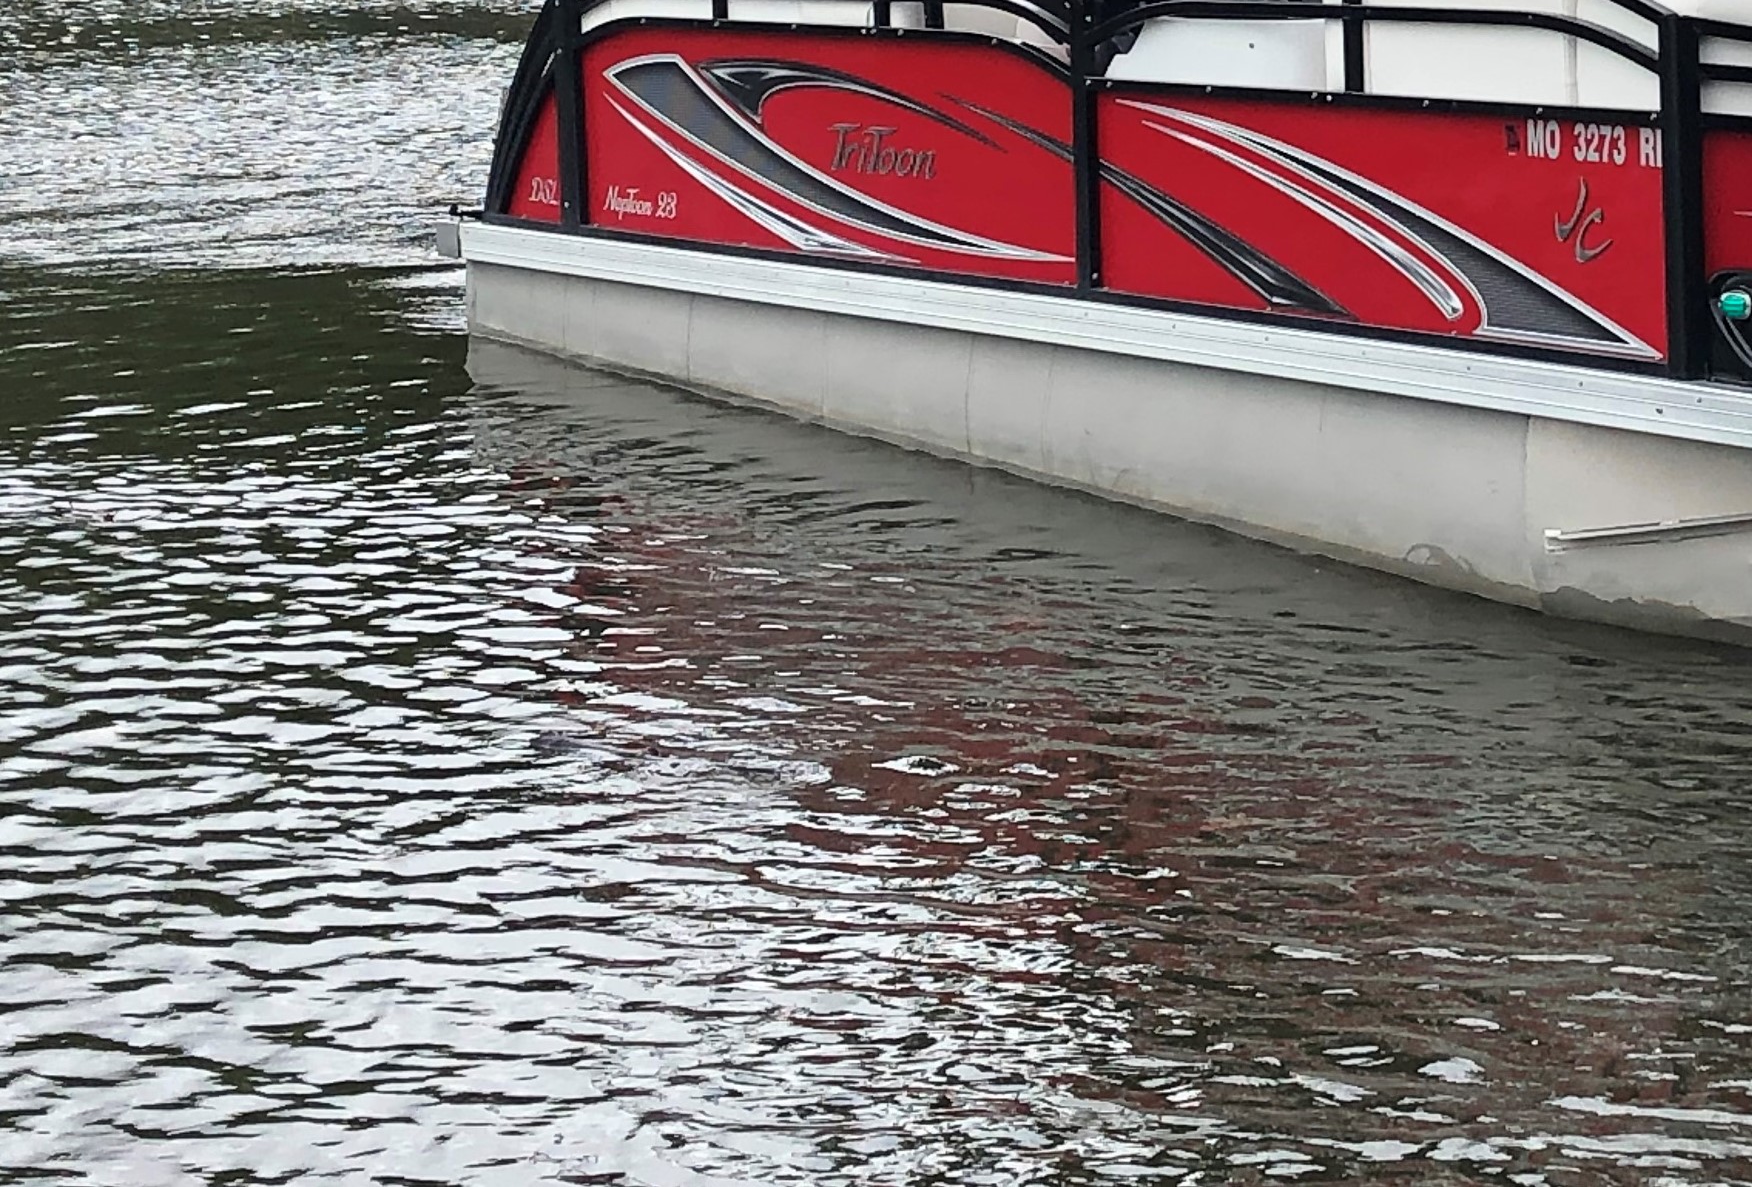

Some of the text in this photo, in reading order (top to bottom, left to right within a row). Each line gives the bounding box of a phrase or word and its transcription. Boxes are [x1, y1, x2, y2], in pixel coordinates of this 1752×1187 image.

[827, 122, 936, 180] TriToon
[1526, 119, 1560, 159] MO
[1573, 122, 1626, 165] 3273
[655, 191, 678, 219] 23
